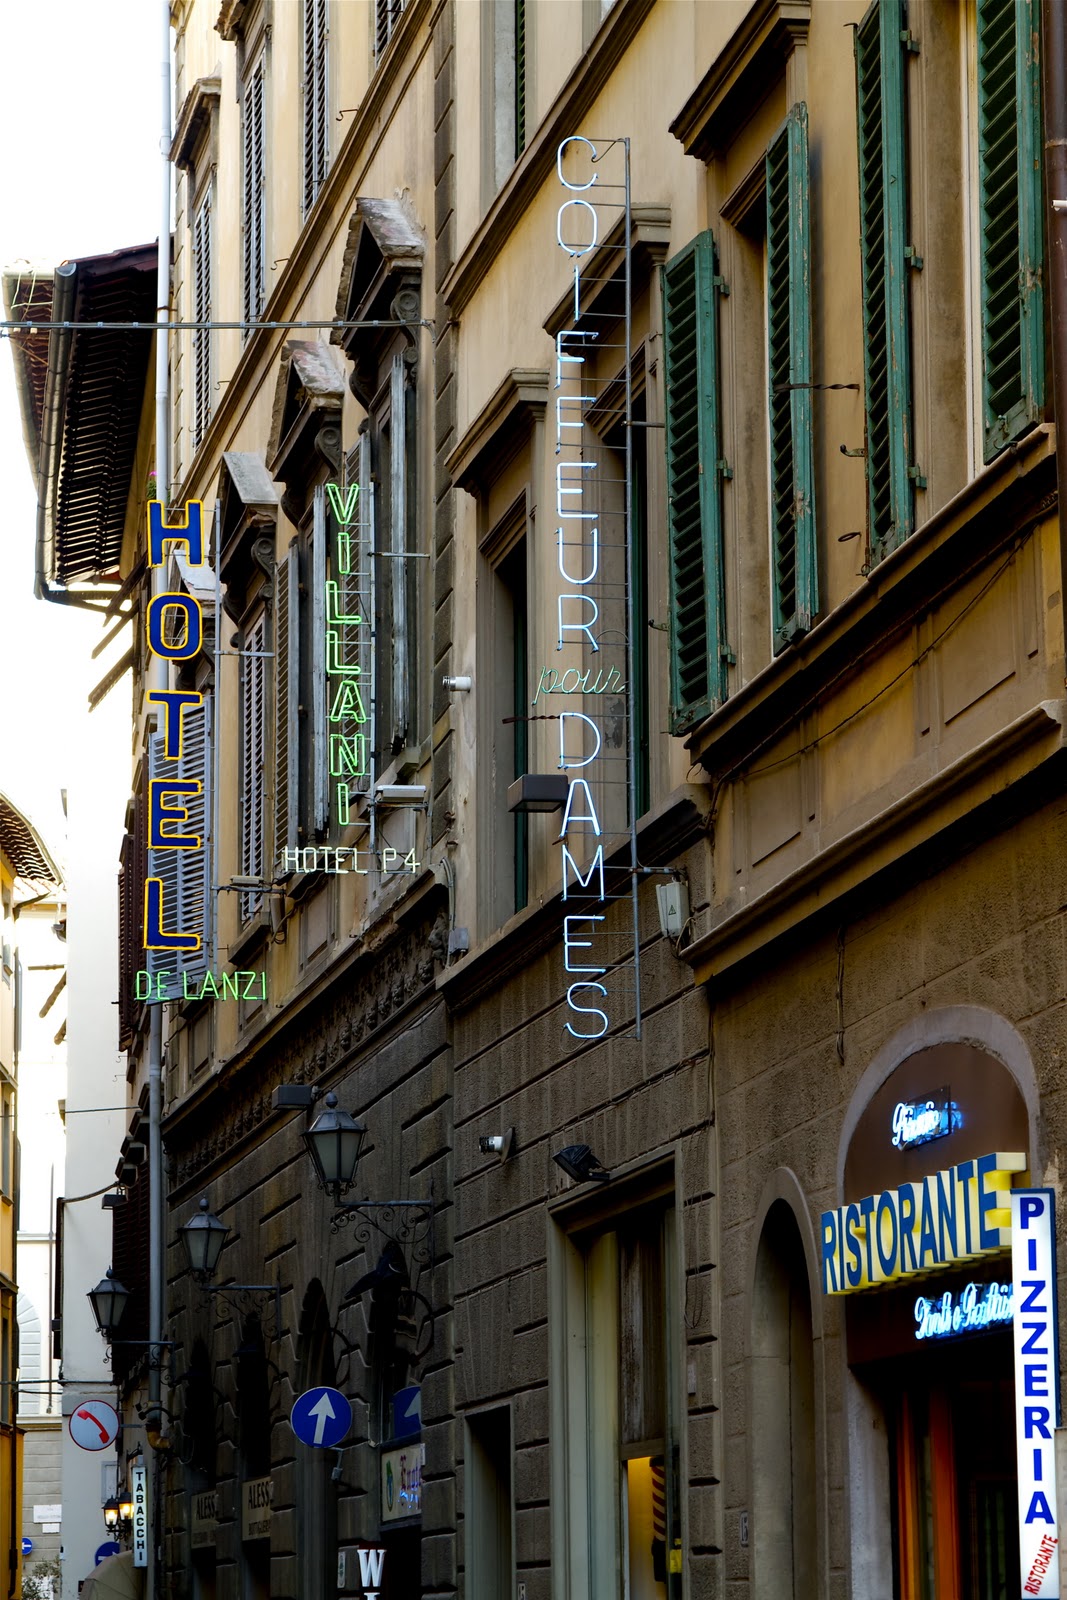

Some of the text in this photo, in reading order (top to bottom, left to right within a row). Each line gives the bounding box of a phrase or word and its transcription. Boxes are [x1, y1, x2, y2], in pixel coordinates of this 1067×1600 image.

[555, 135, 601, 653] COIFFEUR
[324, 483, 366, 826] VILLANI
[530, 664, 626, 705] pour
[143, 499, 204, 951] HOTEL
[283, 846, 369, 875] HOTEL
[556, 711, 609, 1039] DAMES
[135, 970, 267, 1001] DE LANZI
[821, 1153, 1003, 1295] RISTORANTE
[1019, 1197, 1055, 1525] PIZZERIA
[135, 1471, 146, 1561] TABACCHI
[196, 1494, 217, 1521] ALESS
[248, 1480, 271, 1510] ALESS
[1024, 1534, 1059, 1595] RISTORANTE
